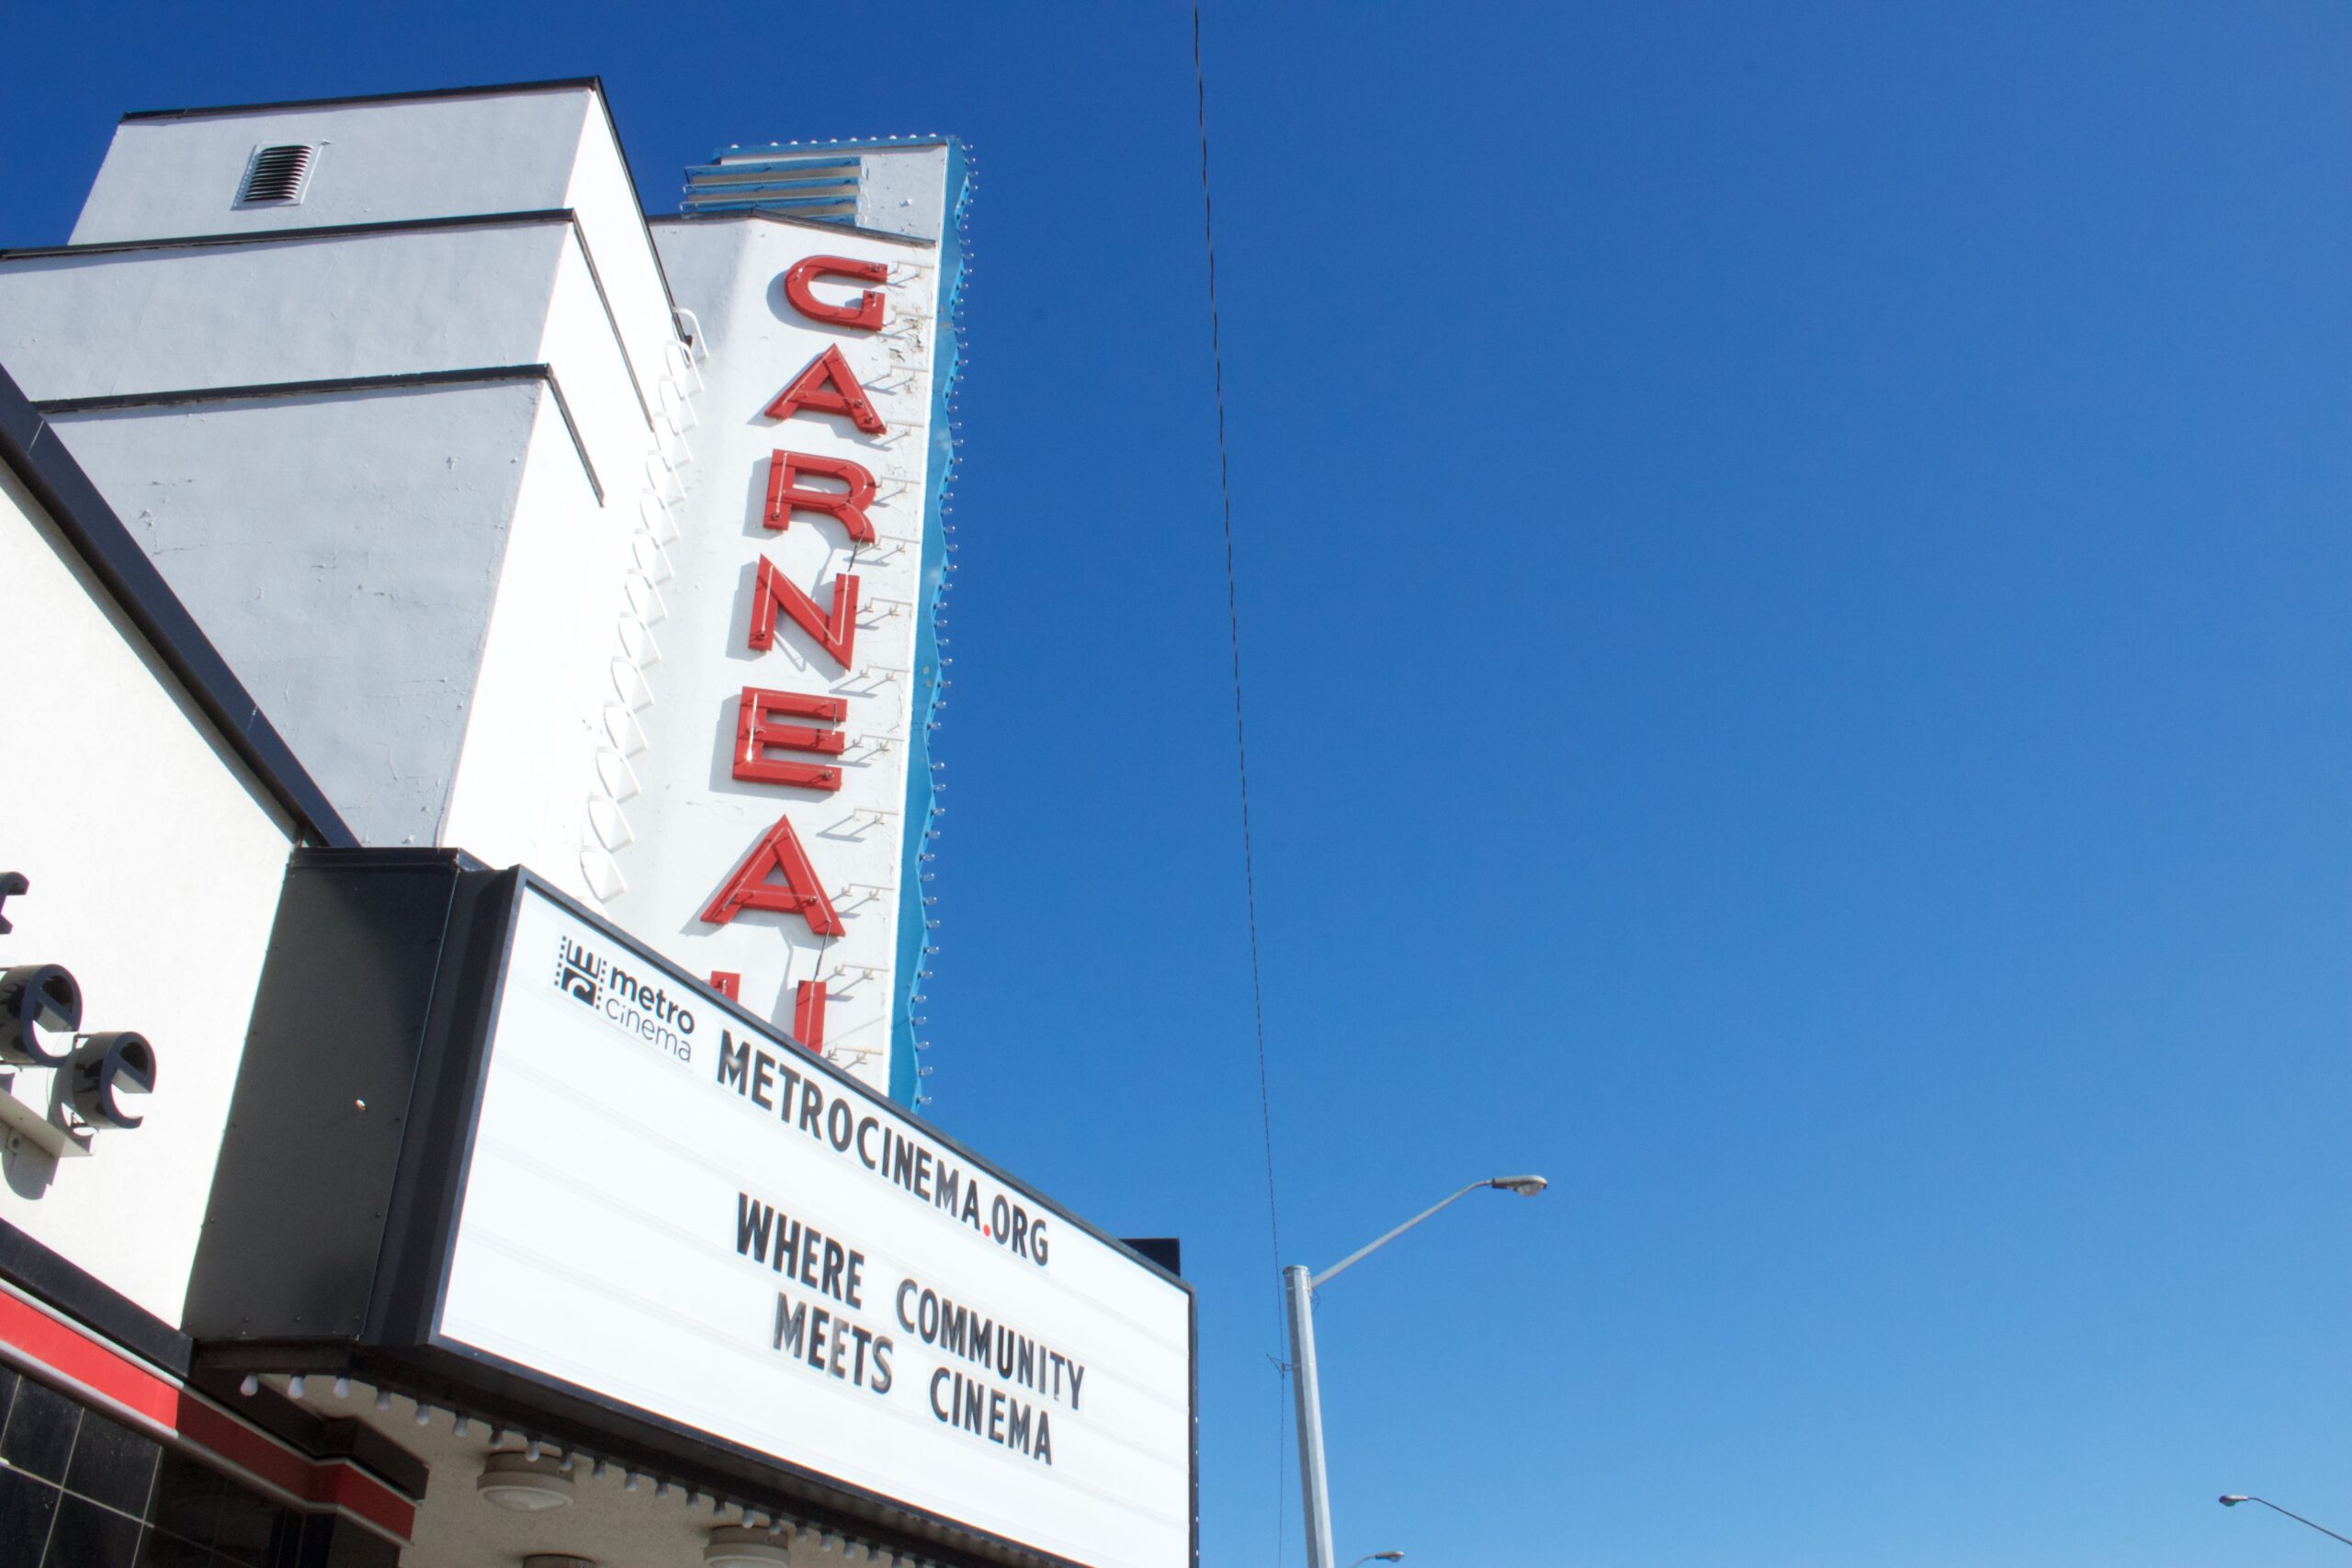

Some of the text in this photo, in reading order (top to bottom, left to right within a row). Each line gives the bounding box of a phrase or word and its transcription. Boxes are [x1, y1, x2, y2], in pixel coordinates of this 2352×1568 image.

[605, 998, 691, 1062] cinema
[609, 966, 695, 1034] metro
[716, 1028, 1049, 1267] METROCINEMA.ORG
[737, 1191, 1085, 1412] WHERE COMMUNITY
[773, 1292, 1053, 1466] MEETS CINEMA
